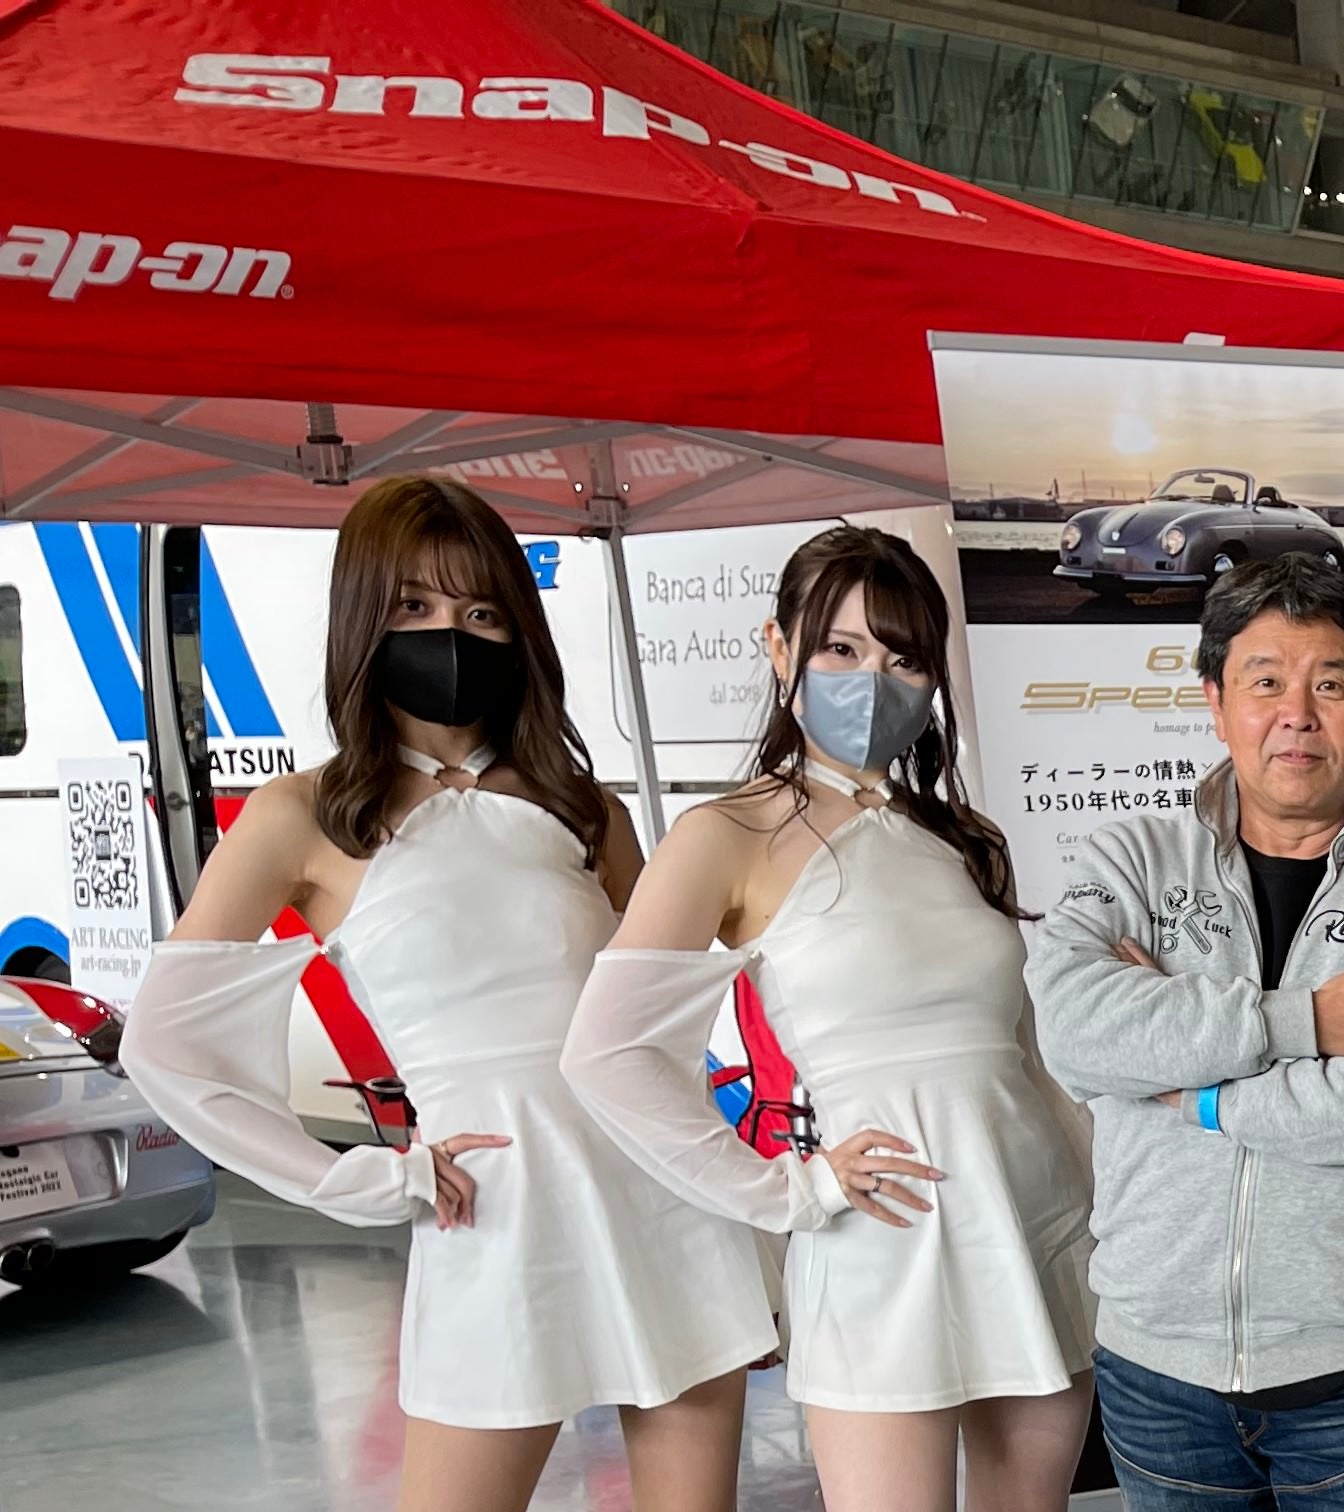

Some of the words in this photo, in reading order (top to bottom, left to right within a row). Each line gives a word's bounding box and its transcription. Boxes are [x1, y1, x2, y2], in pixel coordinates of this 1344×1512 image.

[175, 53, 961, 217] Snap-on
[647, 571, 706, 604] Banca
[713, 564, 733, 602] di
[684, 629, 743, 662] Auto
[1153, 722, 1190, 736] homage
[1194, 723, 1203, 733] to
[1023, 788, 1194, 812] 1950年代の名車
[71, 926, 96, 949] ART
[98, 927, 149, 951] RACING
[1204, 919, 1233, 938] Luck
